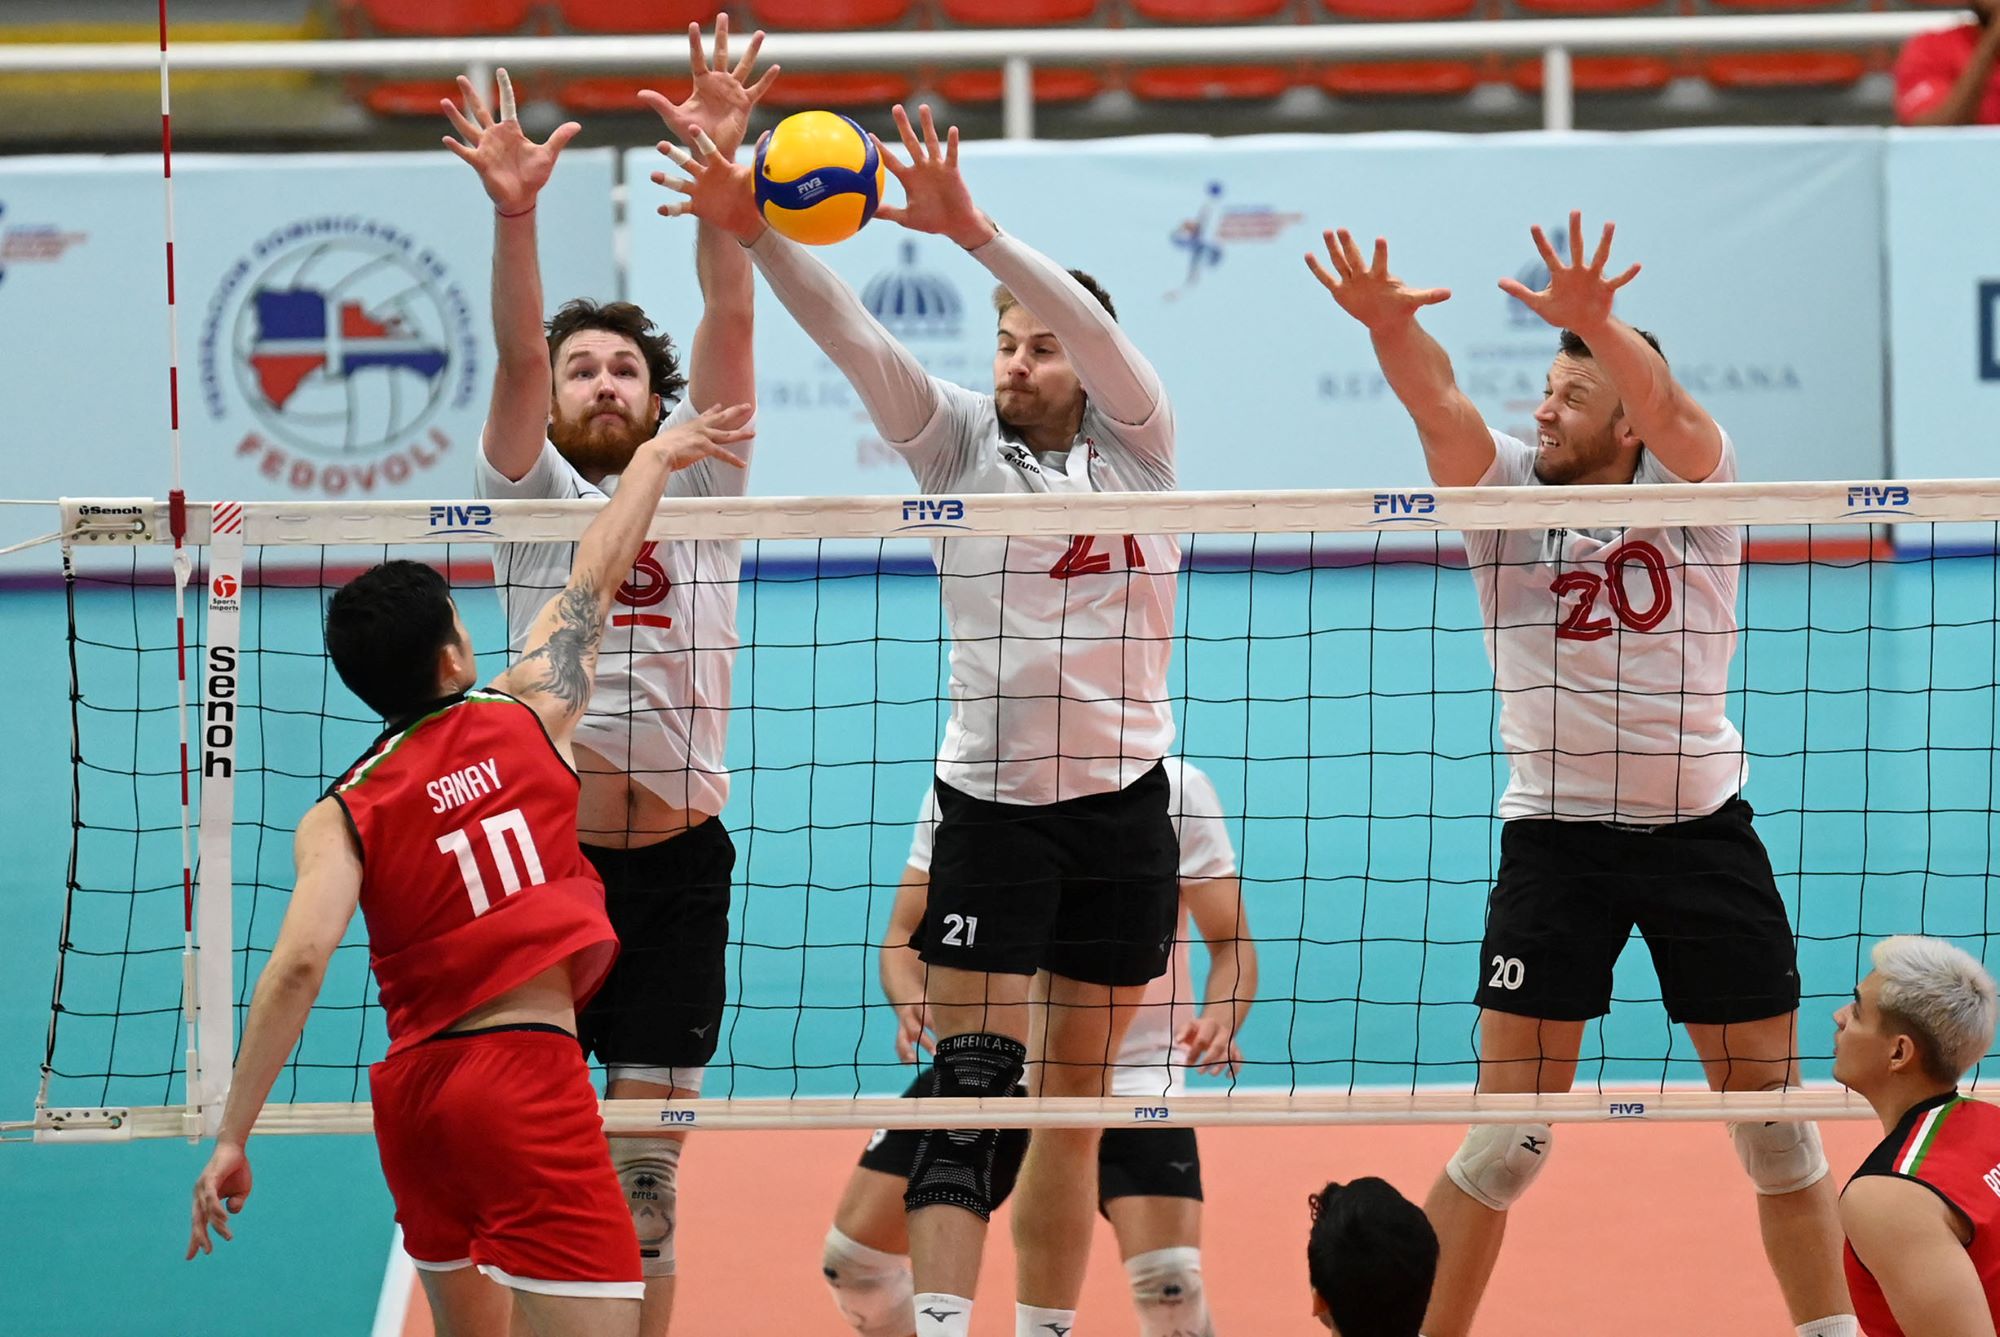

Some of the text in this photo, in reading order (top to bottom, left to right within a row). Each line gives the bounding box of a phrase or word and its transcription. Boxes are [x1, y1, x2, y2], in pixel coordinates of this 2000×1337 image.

[797, 177, 823, 194] FIVB
[235, 426, 453, 495] FEDOVOLI
[1374, 494, 1435, 514] FIVB
[1848, 486, 1910, 507] FIVB
[89, 505, 143, 515] Senoh
[430, 505, 492, 526] FIVB
[903, 500, 964, 521] FIVB
[1549, 540, 1672, 642] 20
[426, 758, 502, 815] SANAY
[435, 808, 547, 919] 10
[941, 913, 978, 947] 21
[1488, 954, 1525, 990] 20
[661, 1110, 695, 1121] FIVB
[1134, 1107, 1169, 1118] FIVB
[1610, 1103, 1645, 1115] FIVB
